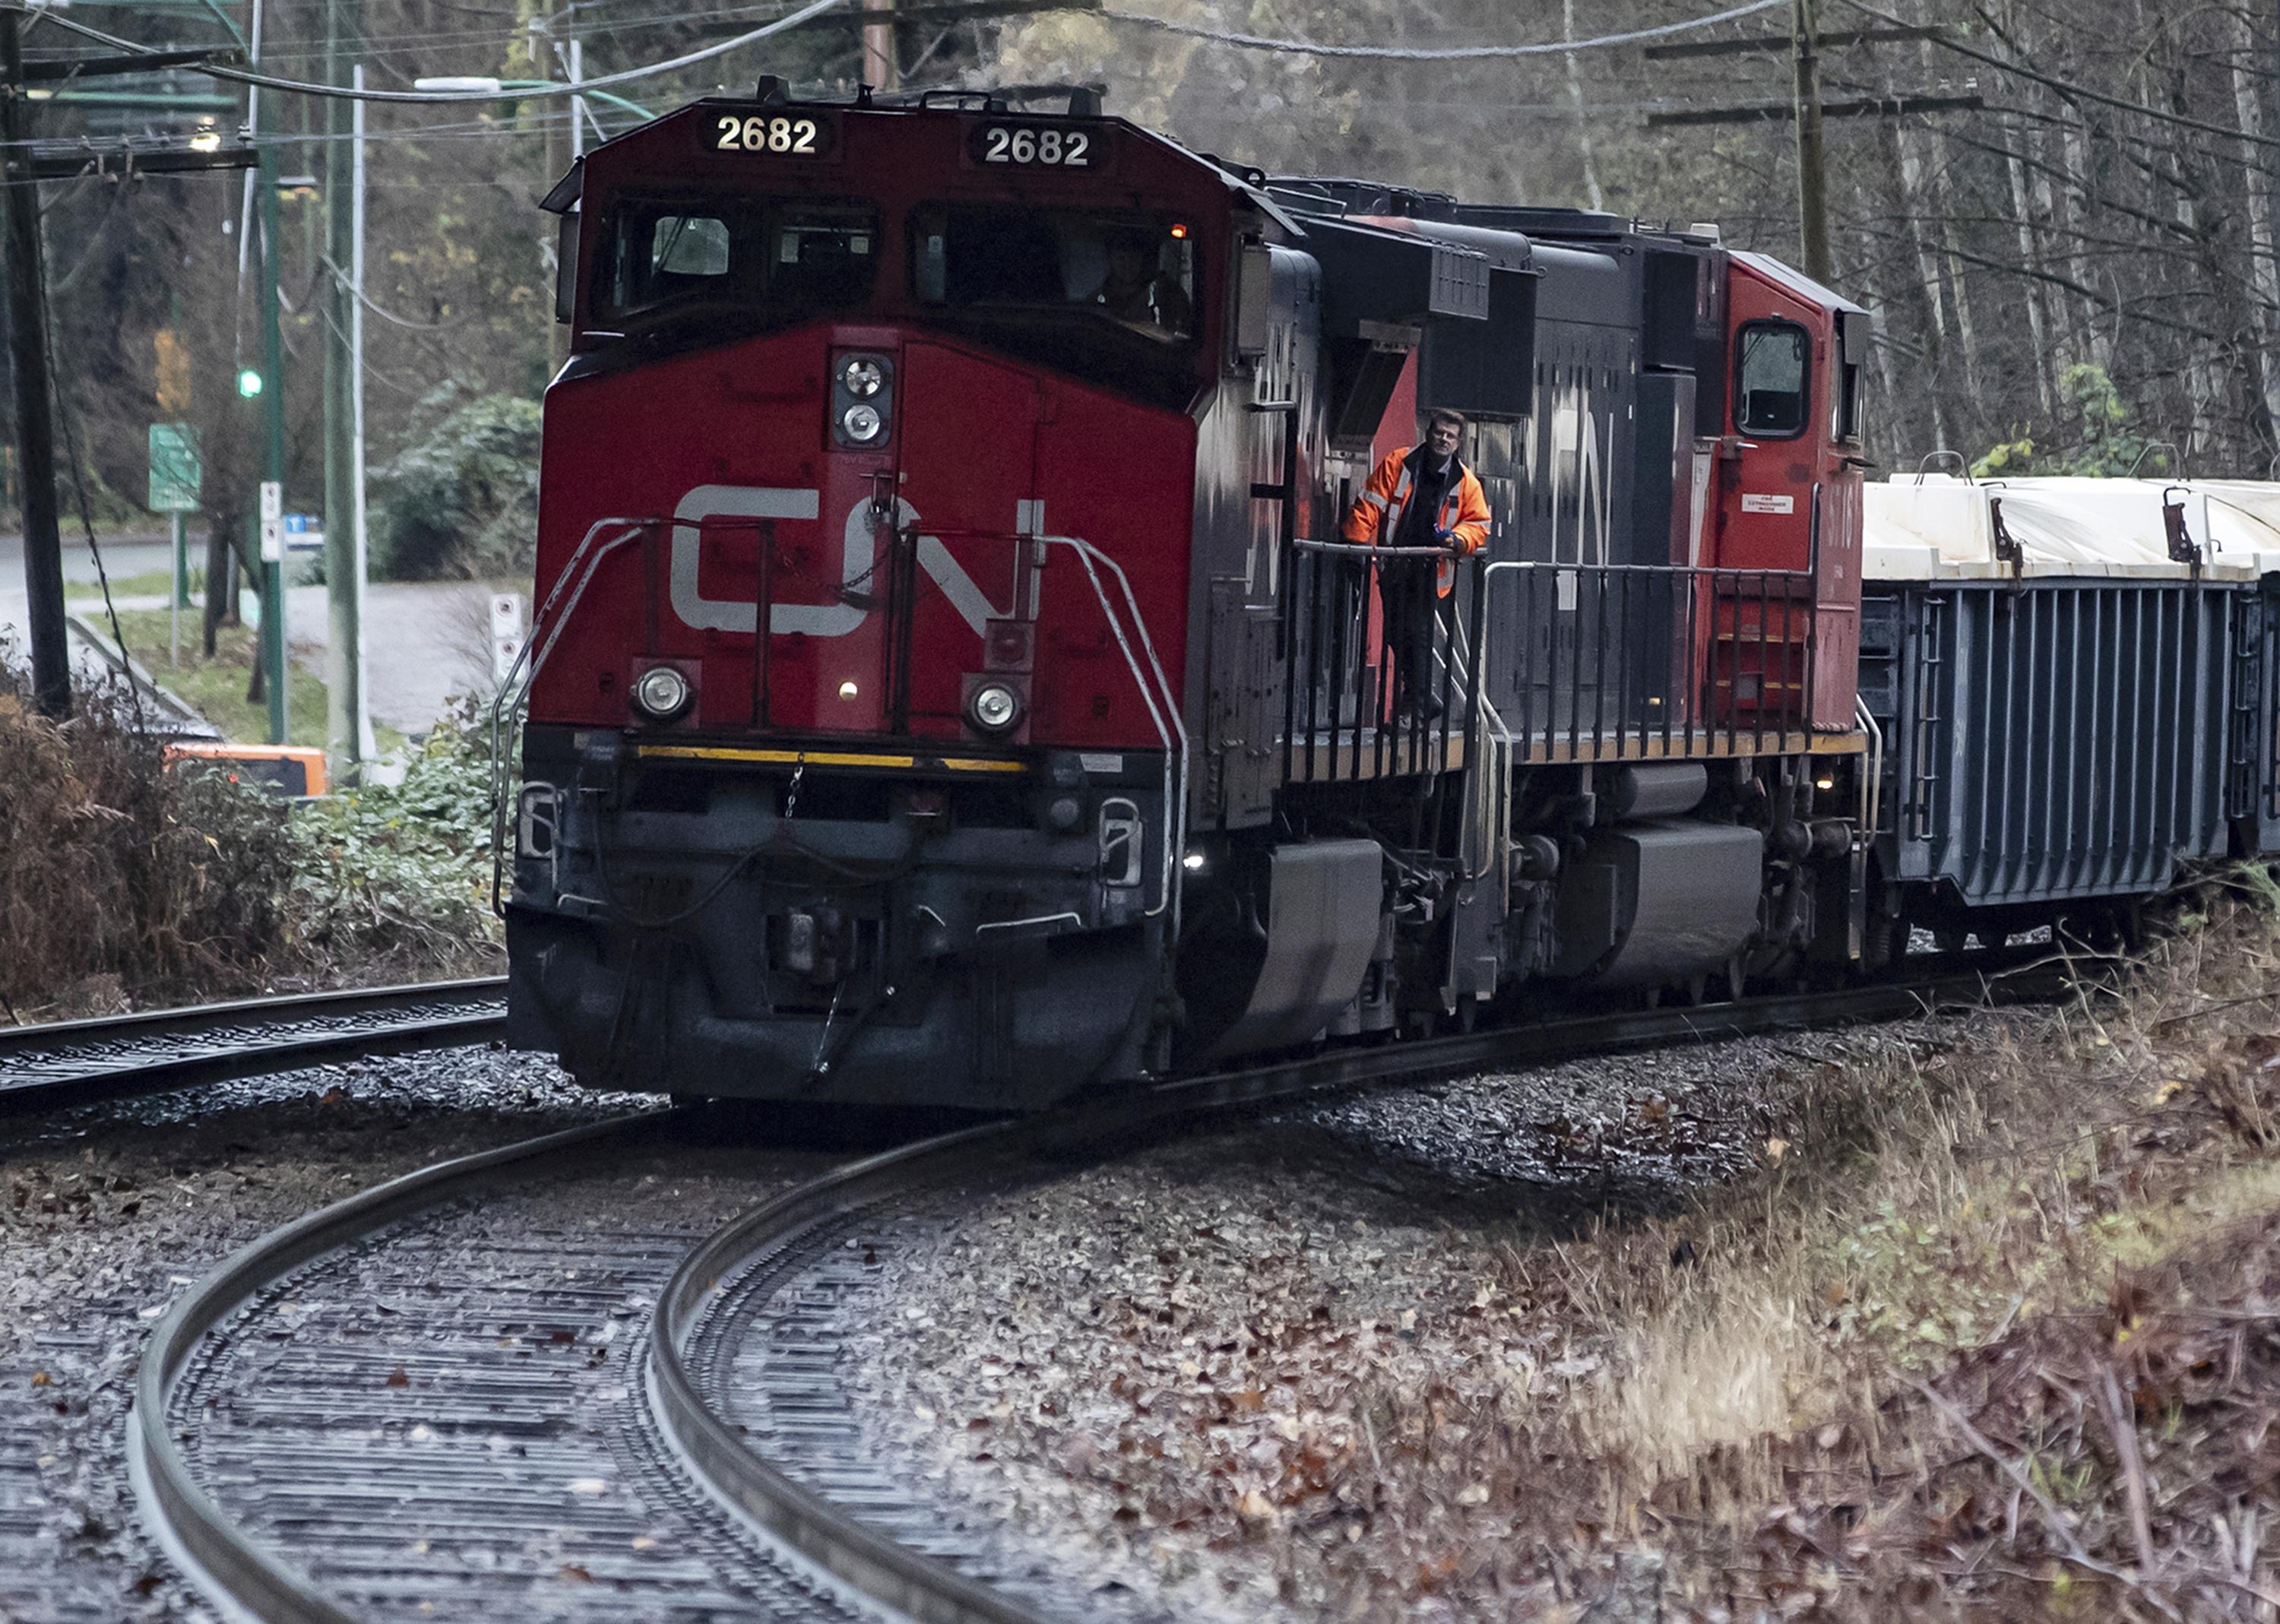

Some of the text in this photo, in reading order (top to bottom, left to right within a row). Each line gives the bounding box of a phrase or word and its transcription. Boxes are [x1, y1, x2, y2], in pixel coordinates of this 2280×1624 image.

[717, 116, 816, 153] 2682
[986, 128, 1088, 165] 2682
[670, 484, 1045, 639] CN
